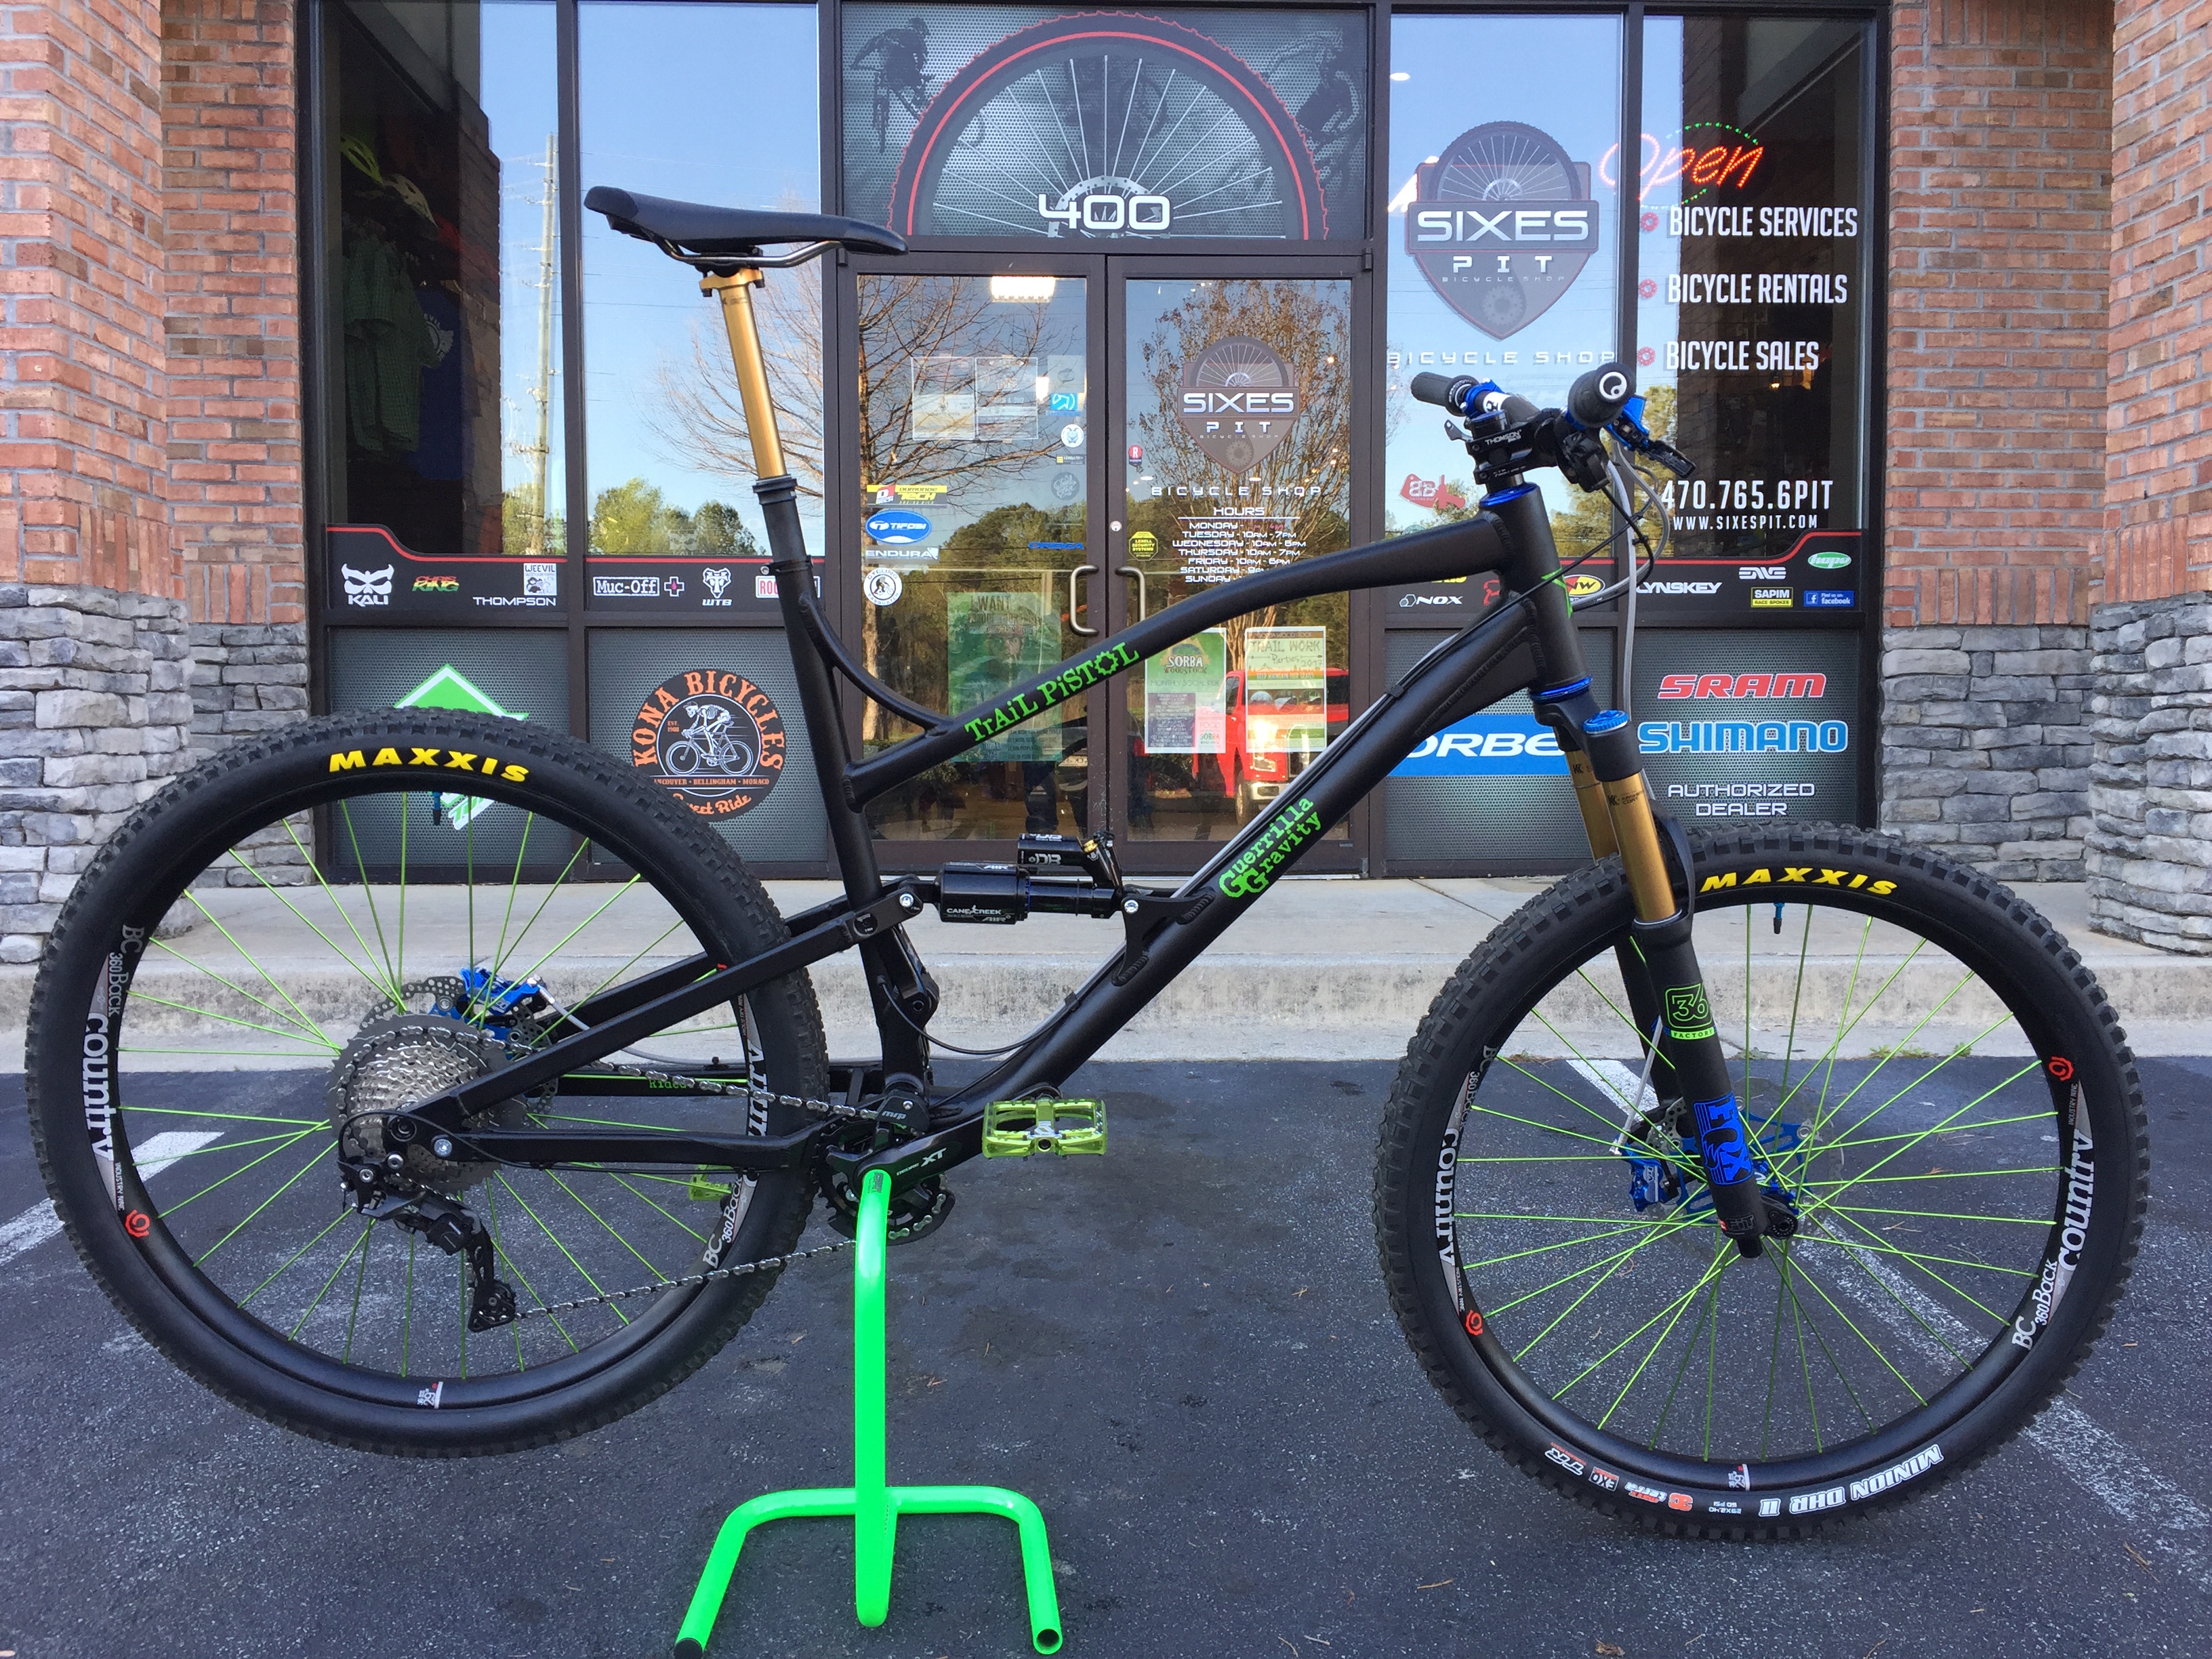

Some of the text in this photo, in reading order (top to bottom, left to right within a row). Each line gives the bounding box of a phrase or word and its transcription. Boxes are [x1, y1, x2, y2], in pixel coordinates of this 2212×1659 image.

[1599, 133, 1764, 201] Open
[1038, 194, 1170, 230] 400
[1670, 207, 1858, 237] BICYCLE SERVICES
[1417, 210, 1589, 241] SIXES
[1453, 255, 1553, 273] PIT
[1668, 274, 1848, 304] BICYCLE RENTALS
[1387, 351, 1616, 364] BICYCLE SHOP
[1666, 341, 1820, 370] BICYCLE SALES
[1183, 392, 1294, 413] SIXES
[1206, 422, 1271, 434] PIT
[1151, 487, 1322, 496] BICYCLE SHOP
[1661, 480, 1833, 510] 470.765.6PIT
[1213, 508, 1265, 516] HOURS
[1673, 515, 1818, 531] WWW.SIXESPIT.COM
[865, 550, 934, 558] ENDURA
[525, 565, 556, 573] WEEVIL
[867, 569, 899, 580] CYCLING
[411, 580, 459, 592] KING
[595, 579, 658, 595] Muc-Off
[1754, 589, 1790, 598] SAPIM
[348, 594, 389, 607] KALI
[472, 596, 556, 607] THOMPSON
[702, 598, 733, 607] WTB
[978, 595, 1011, 611] WANT
[1289, 640, 1320, 652] WORK
[1166, 655, 1204, 668] SORBA
[1658, 673, 1826, 699] SRAM
[632, 670, 785, 771] KONA BICYCLES
[1406, 733, 1565, 758] ORBE
[1637, 720, 1849, 754] SHIMANO
[328, 747, 529, 783] MAXXIS
[1667, 783, 1815, 798] AUTHORIZED
[715, 794, 752, 814] Ride
[1696, 802, 1788, 817] DEALER
[1219, 797, 1314, 898] Guerrilla
[1242, 811, 1322, 893] Gravity
[1699, 867, 1898, 896] MAXXIS
[121, 924, 145, 954] BC
[1671, 985, 1710, 1022] 36
[1673, 1029, 1714, 1040] FACTORY
[82, 1013, 117, 1162] country
[881, 1110, 907, 1120] mrp
[1704, 1094, 1753, 1182] FOX
[921, 1147, 947, 1167] XT
[114, 1162, 123, 1194] INDUSTRY
[1435, 1128, 1460, 1266] country
[2057, 1128, 2095, 1272] country
[721, 1221, 733, 1243] 360
[702, 1233, 723, 1268] BC
[2031, 1258, 2058, 1327] 360 Back
[2011, 1315, 2036, 1351] BC
[1544, 1448, 1584, 1476] TR
[1850, 1443, 1944, 1502] MINION
[1591, 1472, 1616, 1490] EXO
[1789, 1486, 1847, 1515] DHR
